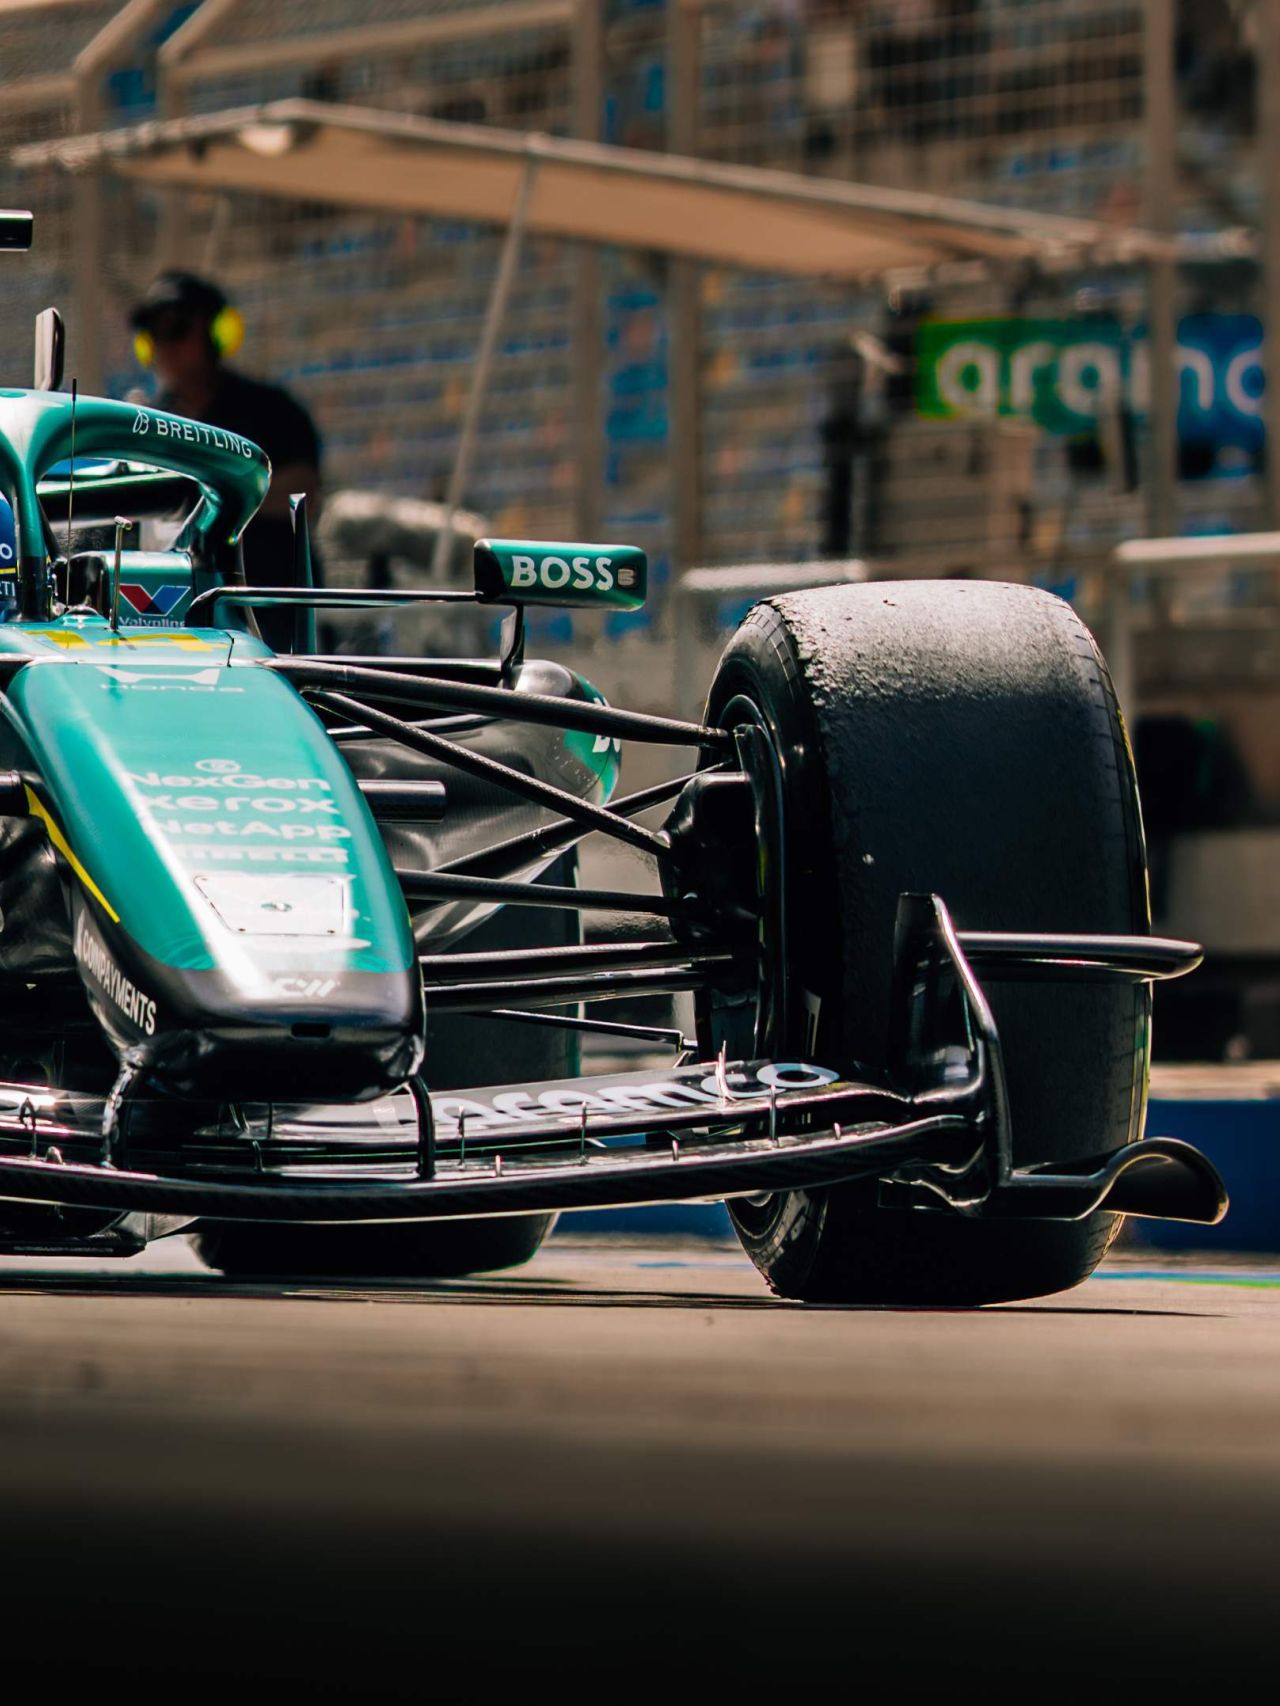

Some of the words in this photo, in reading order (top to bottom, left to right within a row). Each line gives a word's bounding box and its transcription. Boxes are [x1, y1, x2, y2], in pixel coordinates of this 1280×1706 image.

[935, 340, 1264, 416] aramc
[156, 418, 252, 458] BREITLING
[510, 555, 614, 591] BOSS
[118, 616, 185, 627] Valvoline
[125, 772, 331, 791] NexGen
[160, 819, 352, 840] NetApp
